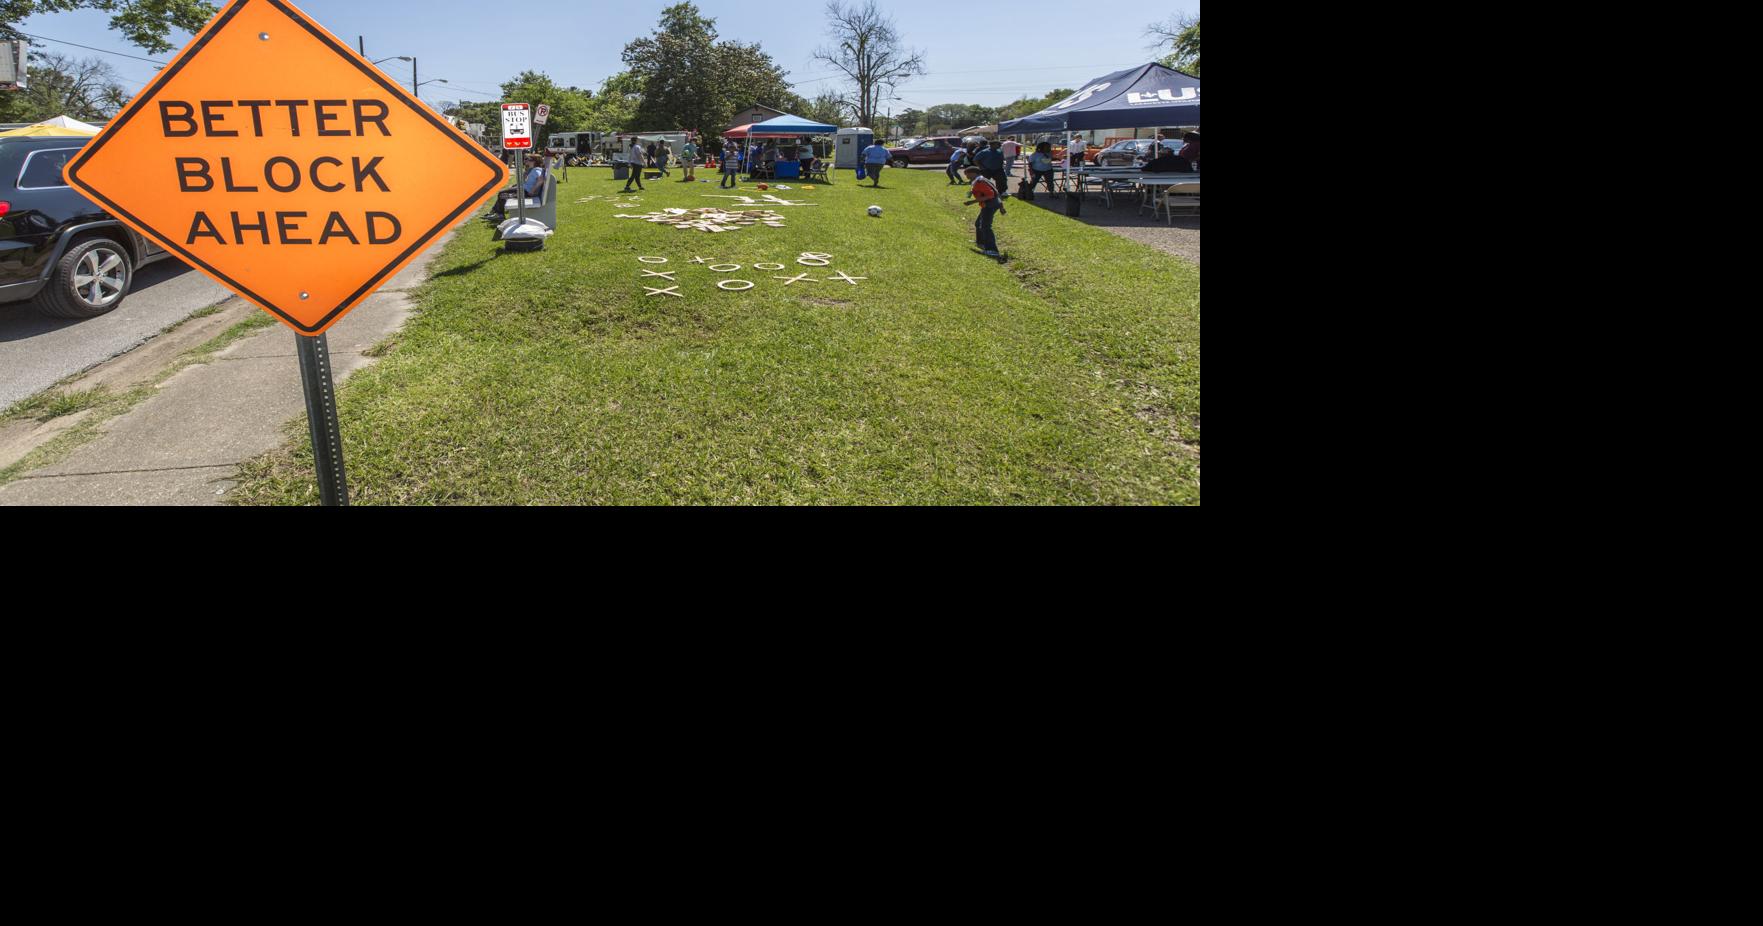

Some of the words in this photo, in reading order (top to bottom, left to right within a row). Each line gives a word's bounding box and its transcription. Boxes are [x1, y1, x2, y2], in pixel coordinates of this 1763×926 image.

[1127, 86, 1200, 104] LU
[158, 98, 392, 137] BETTER
[175, 156, 392, 193] BLOCK
[185, 211, 402, 245] AHEAD
